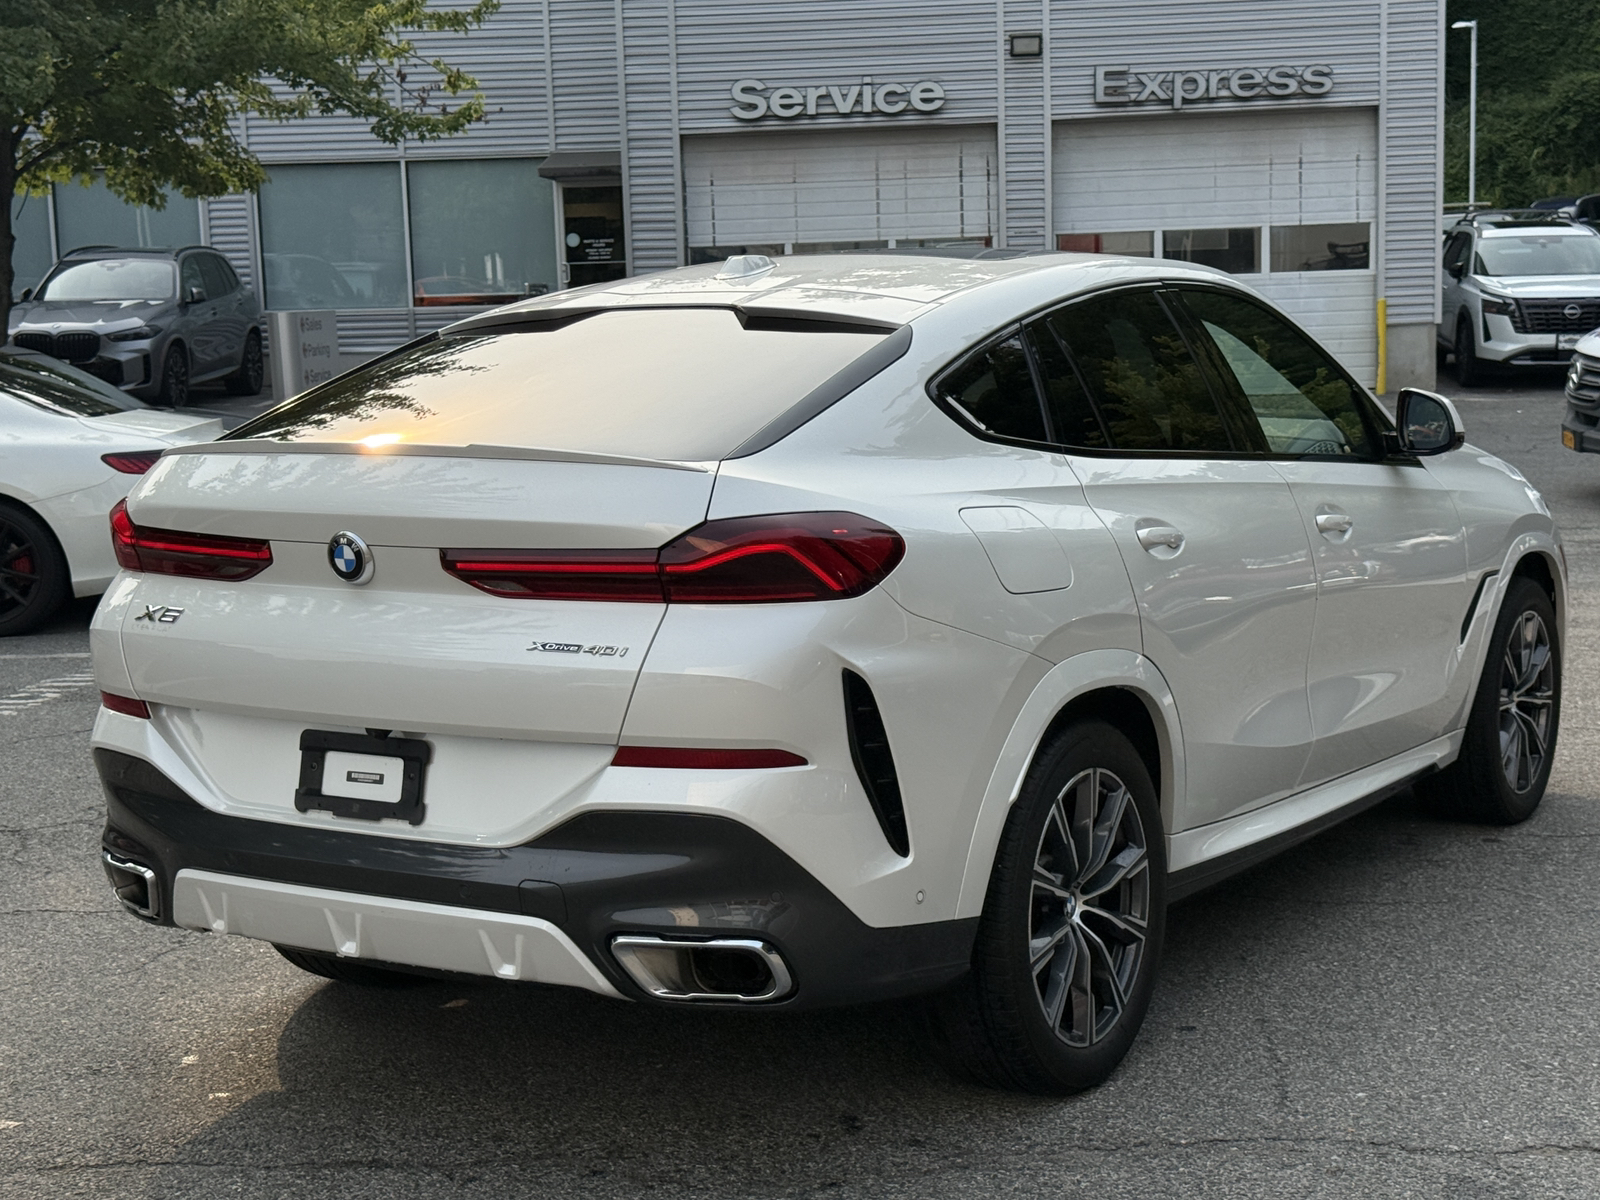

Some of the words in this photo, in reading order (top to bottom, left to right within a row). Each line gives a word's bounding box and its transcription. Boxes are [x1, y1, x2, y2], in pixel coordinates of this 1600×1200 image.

[1094, 64, 1334, 110] Express
[729, 76, 945, 120] Service
[305, 317, 322, 331] Sales
[307, 343, 330, 358] Parking
[310, 368, 331, 383] Service
[134, 604, 185, 623] X6
